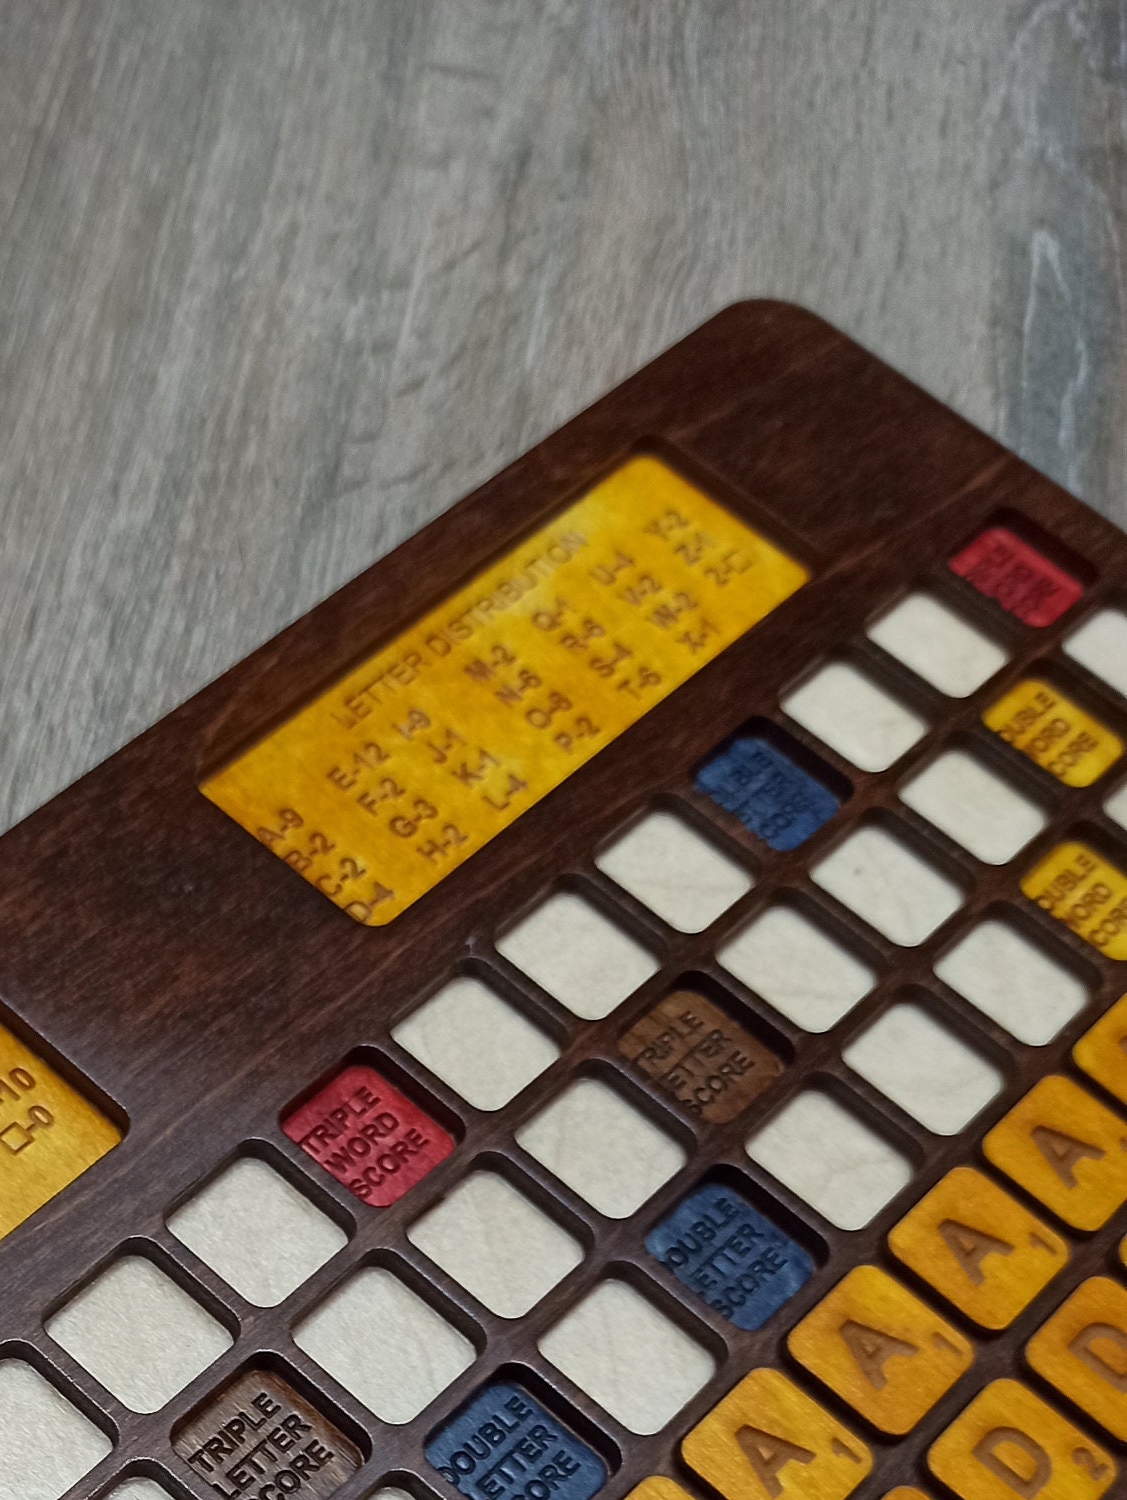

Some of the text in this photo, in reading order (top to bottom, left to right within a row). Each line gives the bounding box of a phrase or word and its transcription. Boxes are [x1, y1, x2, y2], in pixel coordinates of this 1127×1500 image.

[330, 531, 587, 730] LETTER DISTRIBUTION
[327, 741, 390, 790] E-12
[357, 777, 406, 815] F-2
[388, 798, 438, 838] G-3
[416, 823, 469, 864] H-2
[297, 1086, 382, 1154] TRIPLE
[325, 1112, 400, 1174] WORD
[349, 1128, 430, 1198] SCORE
[1030, 1124, 1106, 1190] A
[937, 1218, 1015, 1287] A
[838, 1318, 964, 1391] A 1
[187, 1392, 282, 1473] TRIPLE
[734, 1423, 863, 1500] A 1
[971, 1426, 1109, 1500] D 2
